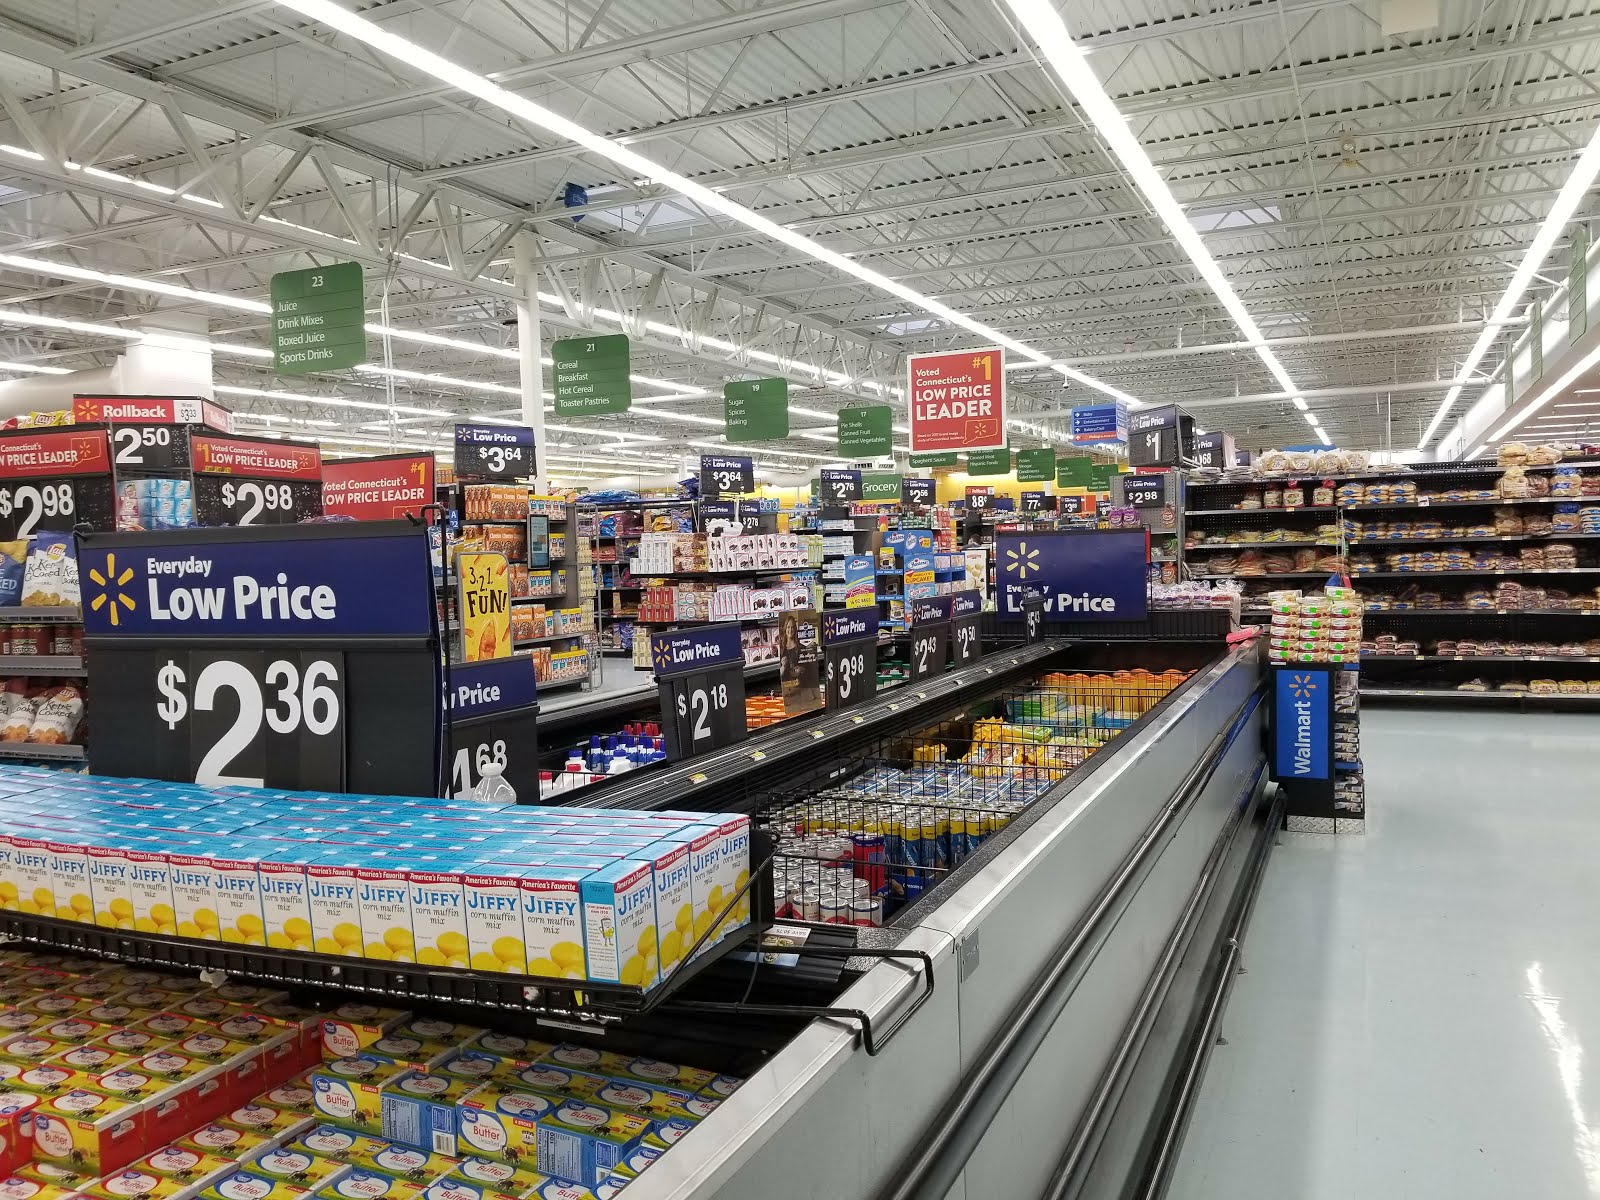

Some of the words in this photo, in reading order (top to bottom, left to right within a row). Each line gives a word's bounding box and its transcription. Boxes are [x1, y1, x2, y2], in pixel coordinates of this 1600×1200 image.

[312, 276, 324, 288] 23
[278, 302, 298, 312] Juice
[278, 318, 300, 330] Drink
[301, 316, 324, 327] Mixes
[279, 334, 303, 347] Boxed
[305, 333, 325, 344] Juice
[586, 344, 595, 352] 21
[280, 353, 306, 365] Sports
[307, 348, 333, 360] Drinks
[557, 360, 578, 370] Cereal
[972, 355, 991, 381] #1
[558, 373, 589, 383] Breakfast
[916, 368, 940, 377] Voted
[916, 375, 972, 387] Connecticut's
[560, 387, 572, 395] Hot
[573, 384, 594, 393] Cereal
[916, 388, 946, 402] LOW
[950, 384, 991, 399] PRICE
[560, 399, 583, 408] Toaster
[585, 397, 610, 406] Pastries
[103, 405, 167, 418] Rollback
[728, 408, 746, 416] Spices
[916, 400, 992, 421] LEADER
[728, 418, 748, 426] Baking
[1140, 420, 1151, 429] Low
[1150, 416, 1165, 427] Price
[473, 433, 493, 442] Low
[494, 433, 517, 443] Price
[1, 443, 42, 453] Connecticut's
[196, 443, 210, 463] #1
[210, 443, 229, 454] Voted
[229, 445, 268, 457] Connecticut's
[7, 453, 38, 465] PRICE
[39, 450, 79, 464] LEADER
[211, 452, 233, 465] LOW
[235, 455, 262, 467] PRICE
[264, 457, 299, 470] LEADER
[410, 462, 426, 485] #1
[347, 476, 407, 490] Connecticut's
[862, 482, 898, 495] Grocery
[347, 491, 380, 504] PRICE
[384, 488, 425, 503] LEADER
[451, 511, 457, 519] A
[147, 556, 213, 578] Everyday
[148, 578, 226, 621] Low
[233, 572, 337, 621] Price
[1058, 592, 1116, 612] Price
[466, 590, 508, 618] FUN!
[956, 601, 964, 610] Low
[964, 600, 974, 609] Price
[921, 611, 932, 620] Low
[932, 609, 943, 618] Price
[836, 623, 850, 636] Low
[849, 620, 866, 633] Price
[672, 639, 691, 648] Everyday
[672, 648, 695, 663] Low
[695, 642, 721, 659] Price
[458, 682, 501, 708] Price
[1294, 701, 1311, 776] Walmart
[721, 834, 749, 856] JIFFY
[692, 847, 721, 873] JIFFY
[130, 865, 167, 883] JIFFY
[262, 877, 303, 895] JIFFY
[464, 875, 493, 886] America's
[493, 878, 517, 887] Favorite
[521, 880, 550, 890] America's
[551, 881, 576, 891] Favorite
[412, 887, 460, 907] JIFFY
[467, 891, 517, 911] JIFFY
[617, 883, 652, 916] JIFFY
[523, 895, 577, 916] JIFFY
[527, 916, 547, 925] corn
[547, 915, 576, 927] muffin
[543, 925, 560, 934] mix
[333, 1036, 354, 1047] Butter
[325, 1094, 350, 1108] Butter
[569, 1111, 600, 1122] Butter
[519, 1119, 532, 1128] STICKS
[44, 1132, 68, 1145] Butter
[473, 1125, 500, 1141] Butter
[390, 1153, 418, 1166] Butter
[476, 1164, 505, 1177] Butter
[233, 1183, 261, 1196] Butter
